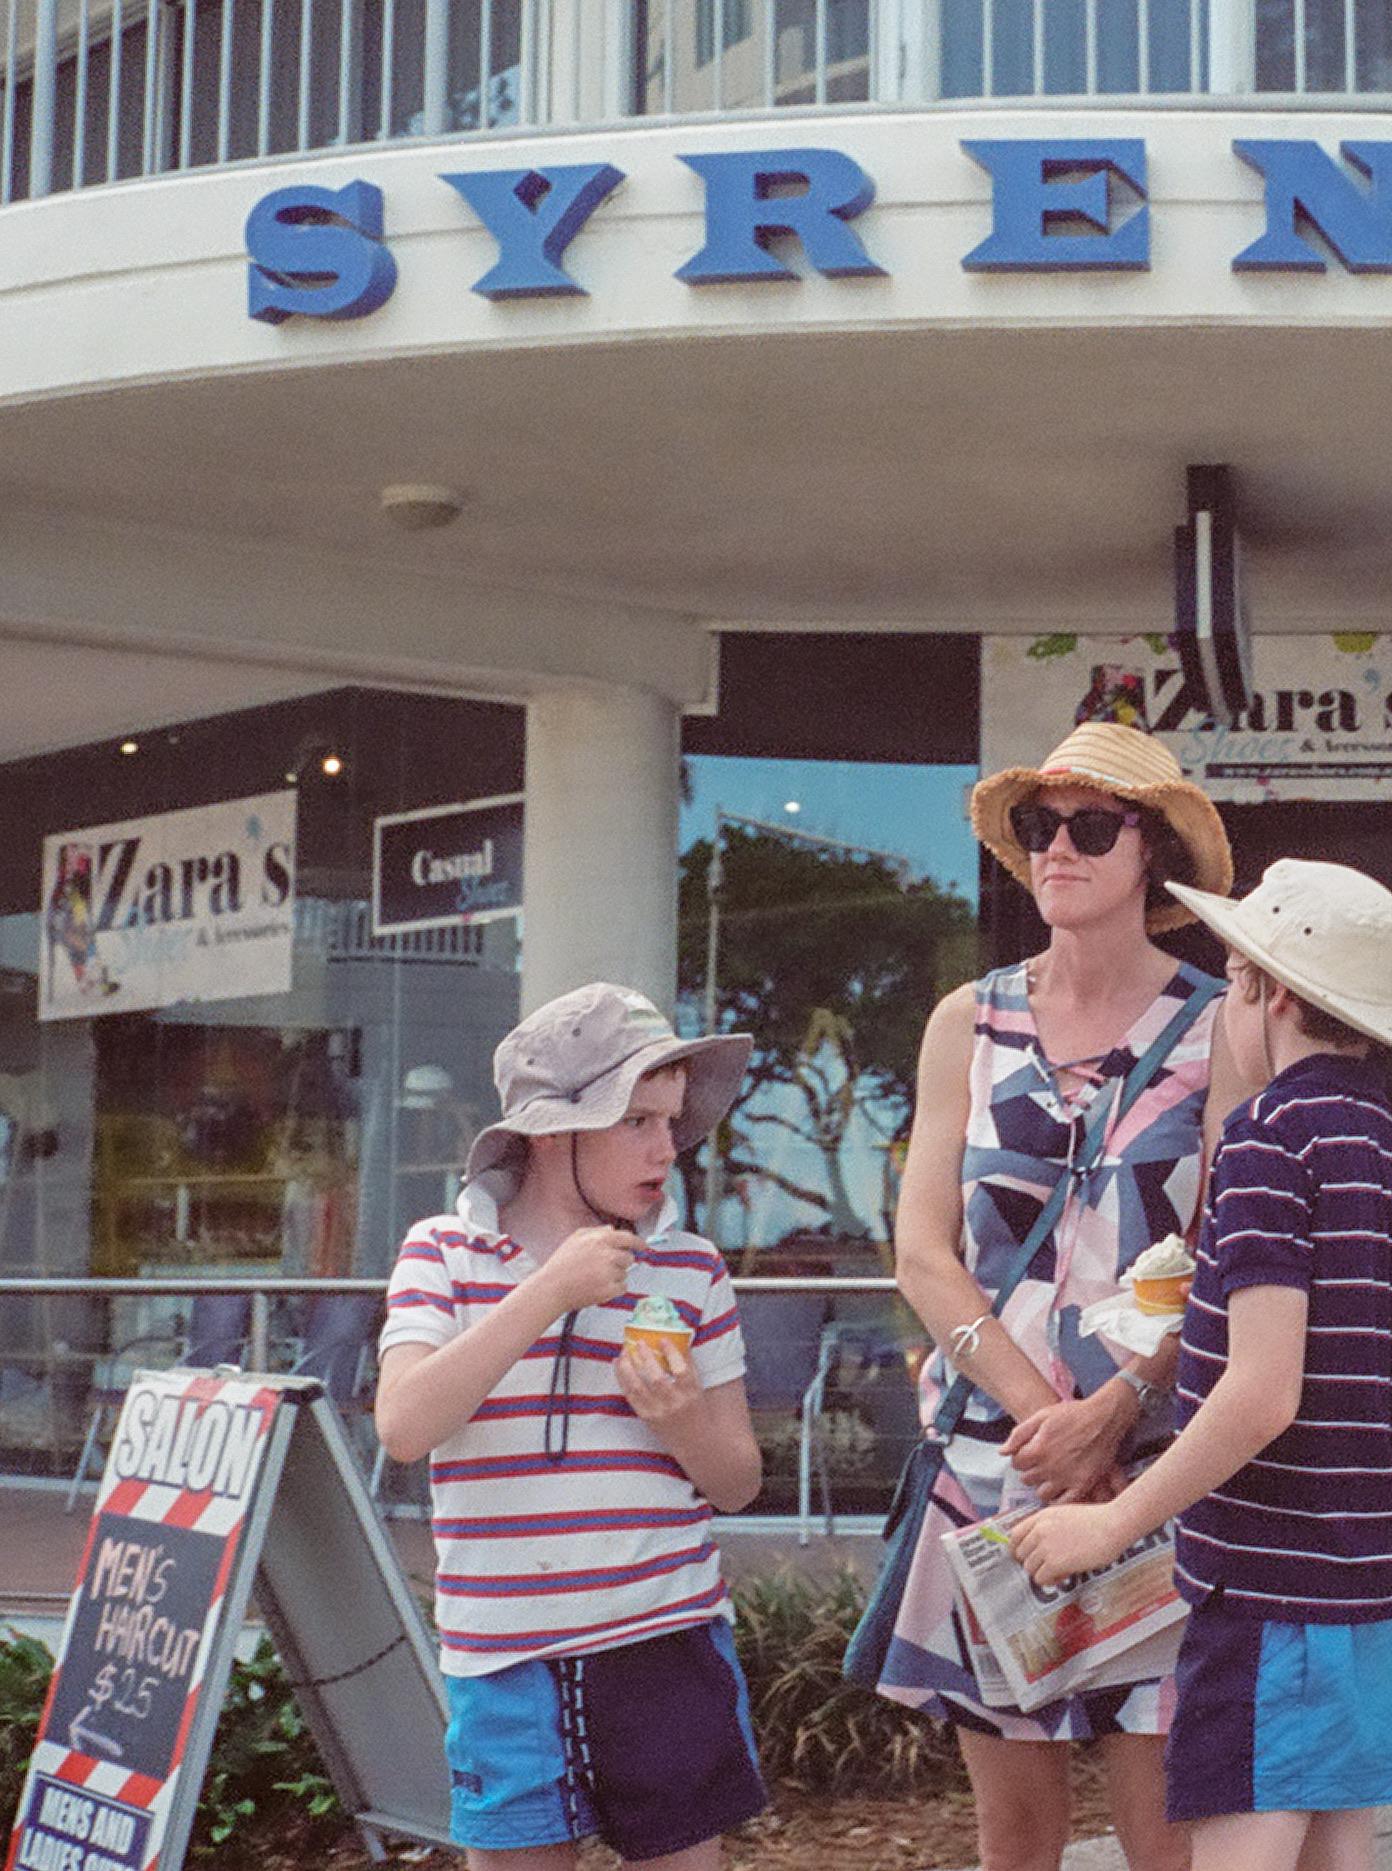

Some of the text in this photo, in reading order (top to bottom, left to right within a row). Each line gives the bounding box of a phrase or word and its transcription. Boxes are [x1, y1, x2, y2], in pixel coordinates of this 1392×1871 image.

[411, 838, 494, 887] Casual
[115, 1389, 264, 1500] SALON
[89, 1536, 177, 1604] MEN'S
[94, 1601, 200, 1678] HAIRCUT
[87, 1661, 162, 1719] $25
[88, 1806, 137, 1855] AND
